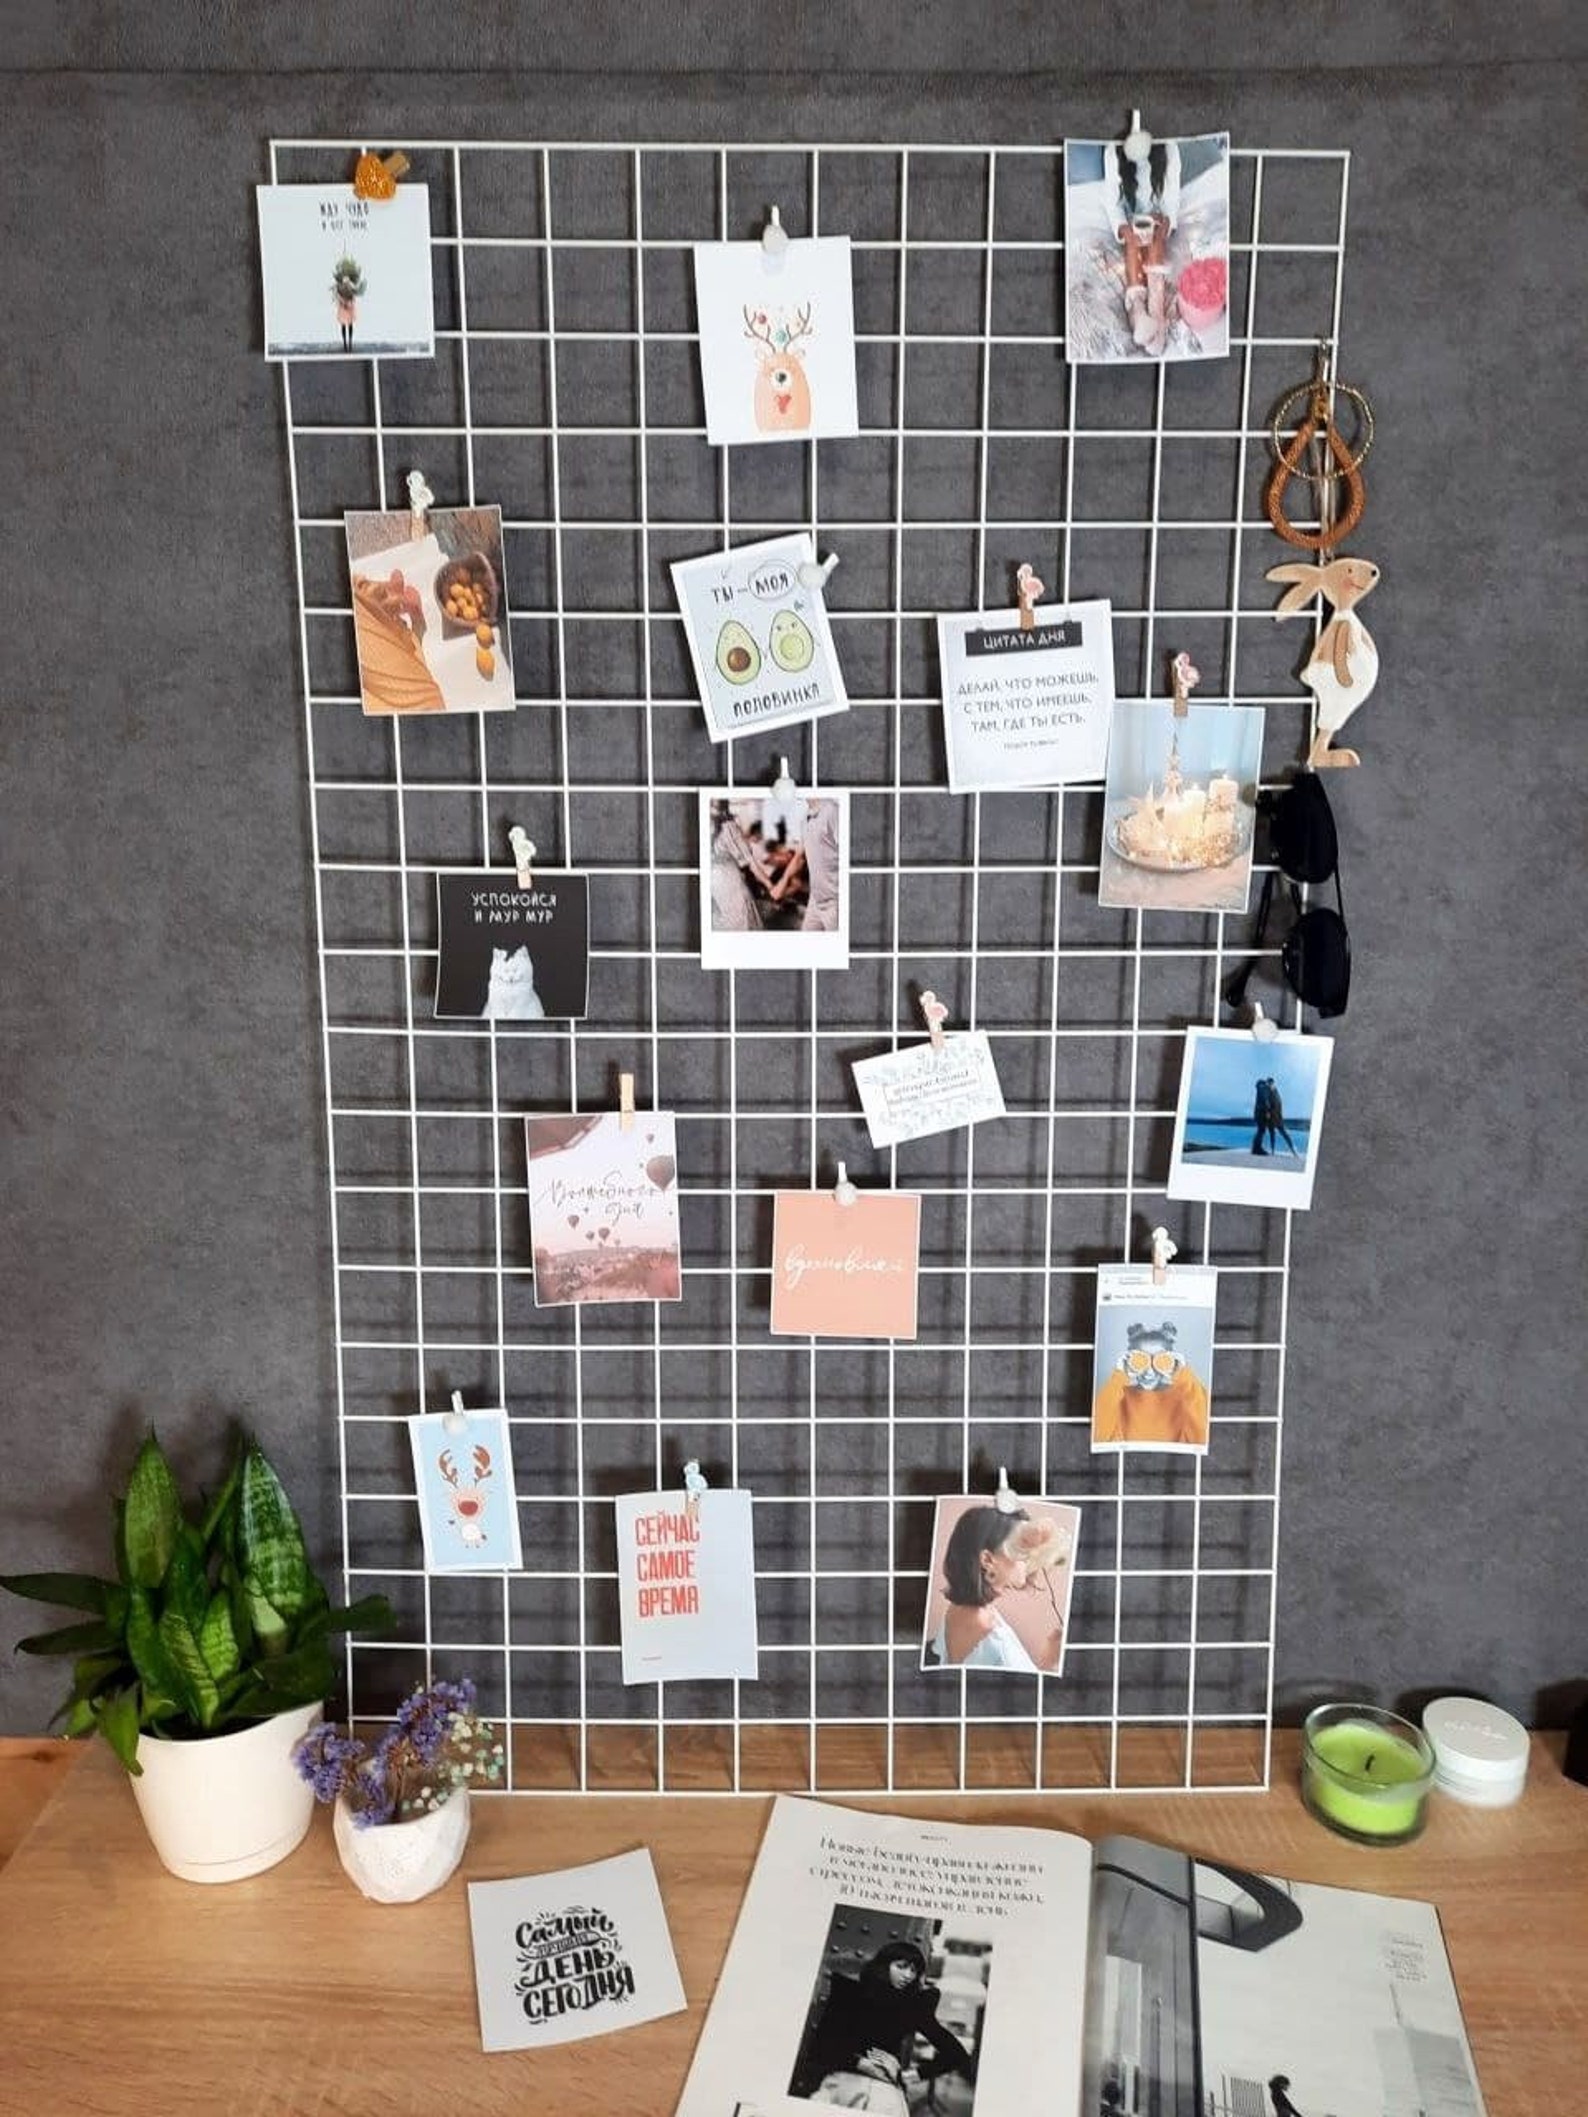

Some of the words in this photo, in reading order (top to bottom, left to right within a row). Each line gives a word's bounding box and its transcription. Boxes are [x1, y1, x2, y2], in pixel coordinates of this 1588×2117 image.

[711, 586, 734, 603] ТЫ
[755, 573, 789, 595] МОЯ
[983, 633, 1035, 649] ЦИТАТА
[1038, 630, 1066, 645] ДНЯ
[1005, 676, 1032, 690] ЧТО
[733, 682, 820, 718] ПОЛОВИНКА
[963, 702, 972, 714] С
[1006, 697, 1033, 711] ЧТО
[1003, 718, 1026, 732] ГДЕ
[1031, 715, 1048, 728] ТЫ
[471, 891, 557, 907] УСПОКОЙСЯ
[474, 909, 483, 923] И
[488, 909, 520, 923] МУР
[525, 909, 554, 923] МУР
[635, 1509, 700, 1546] СЕЙЧАС
[636, 1550, 696, 1582] САМОЕ
[638, 1585, 700, 1618] ВРЕМЯ
[515, 1907, 615, 1949] Самый
[519, 1948, 616, 1987] ДЕНЬ
[523, 1965, 636, 2019] СЕГОДНЯ
